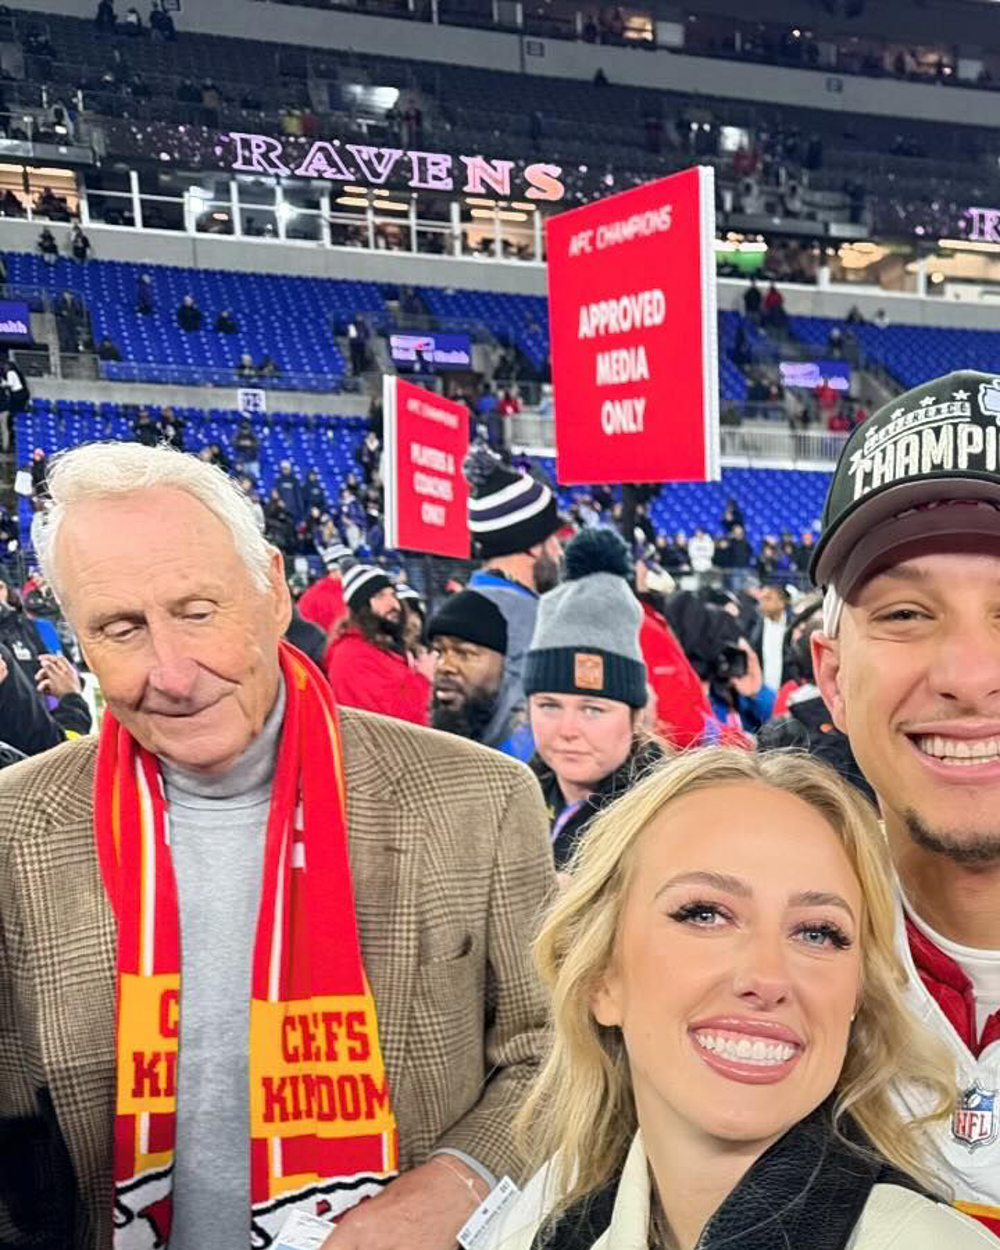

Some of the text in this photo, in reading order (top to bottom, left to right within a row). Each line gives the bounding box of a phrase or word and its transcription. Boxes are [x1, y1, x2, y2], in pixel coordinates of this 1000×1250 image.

[229, 132, 565, 201] RAVENS
[568, 204, 673, 257] AFC CHAMPIONS
[578, 289, 666, 339] APPROVED
[596, 345, 649, 386] MEDIA
[601, 397, 646, 435] ONLY
[956, 1112, 988, 1138] NFL
